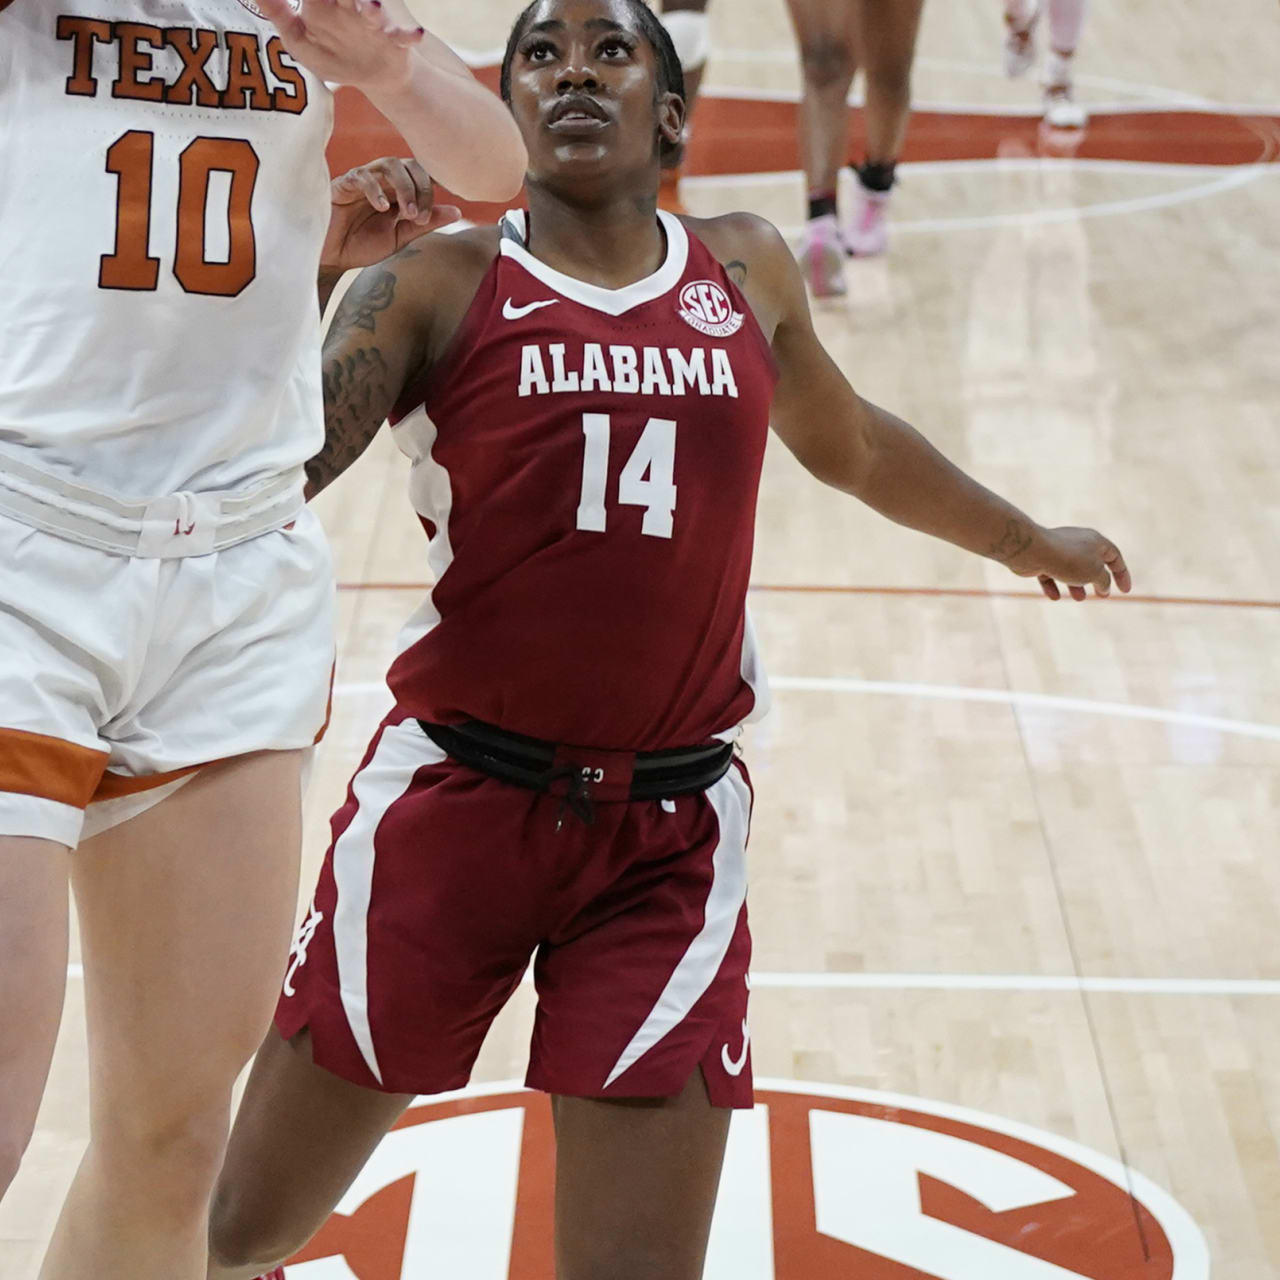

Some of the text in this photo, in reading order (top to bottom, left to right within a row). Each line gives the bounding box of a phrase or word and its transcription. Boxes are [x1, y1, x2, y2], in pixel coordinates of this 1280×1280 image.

[55, 14, 309, 116] TEXAS
[97, 129, 261, 298] 10
[682, 283, 729, 324] SEC
[517, 342, 739, 399] ALABAMA
[575, 412, 678, 540] 14
